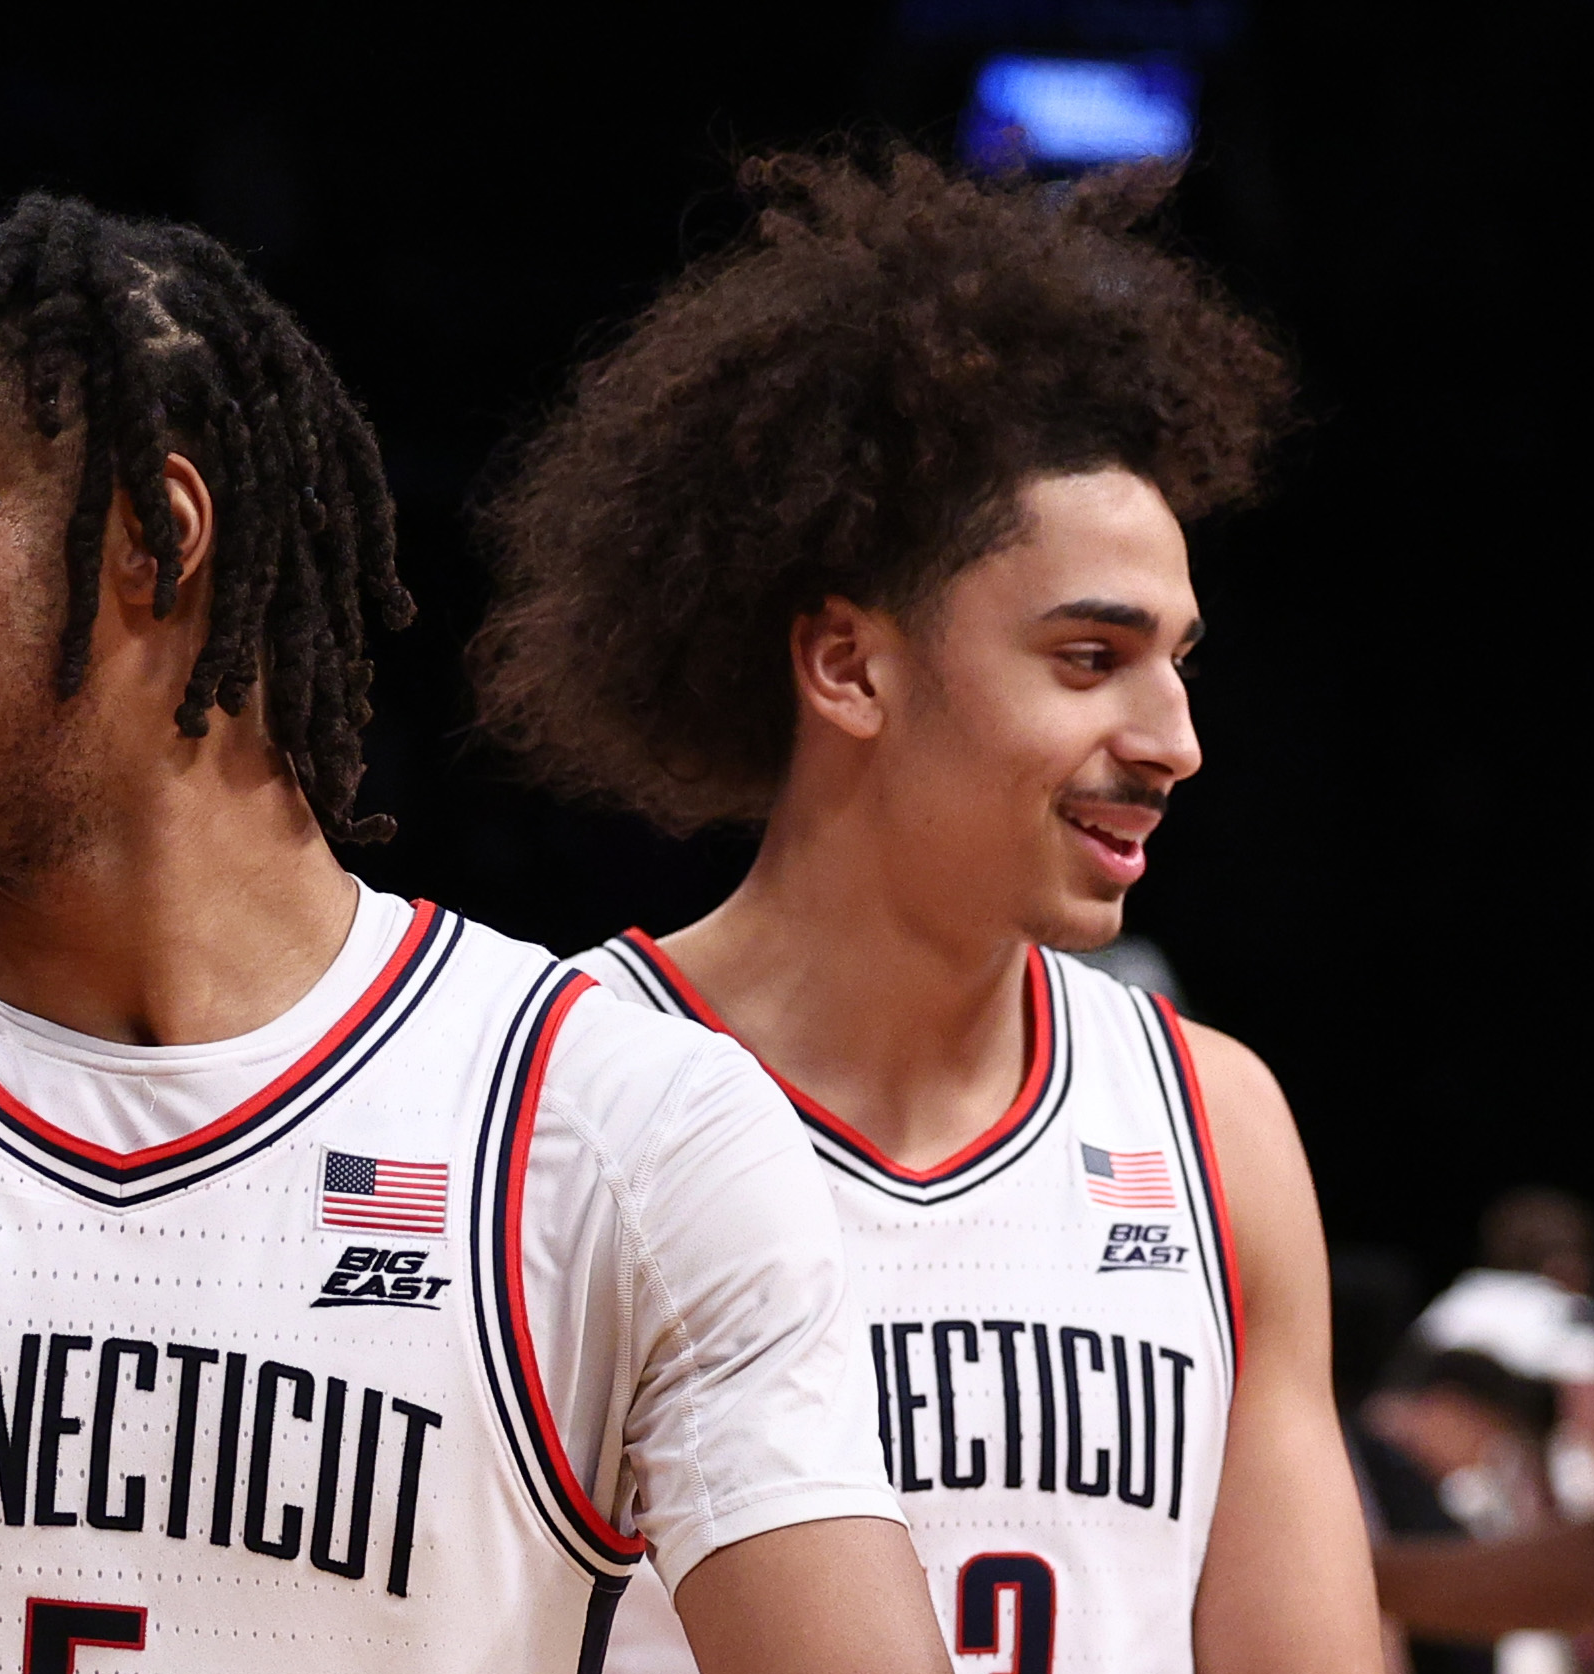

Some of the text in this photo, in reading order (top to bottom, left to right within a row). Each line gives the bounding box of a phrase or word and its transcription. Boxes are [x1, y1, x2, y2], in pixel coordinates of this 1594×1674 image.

[1108, 1223, 1171, 1243] BIG
[336, 1246, 430, 1274] BIG
[1102, 1245, 1189, 1264] EAST
[320, 1271, 453, 1300] EAST
